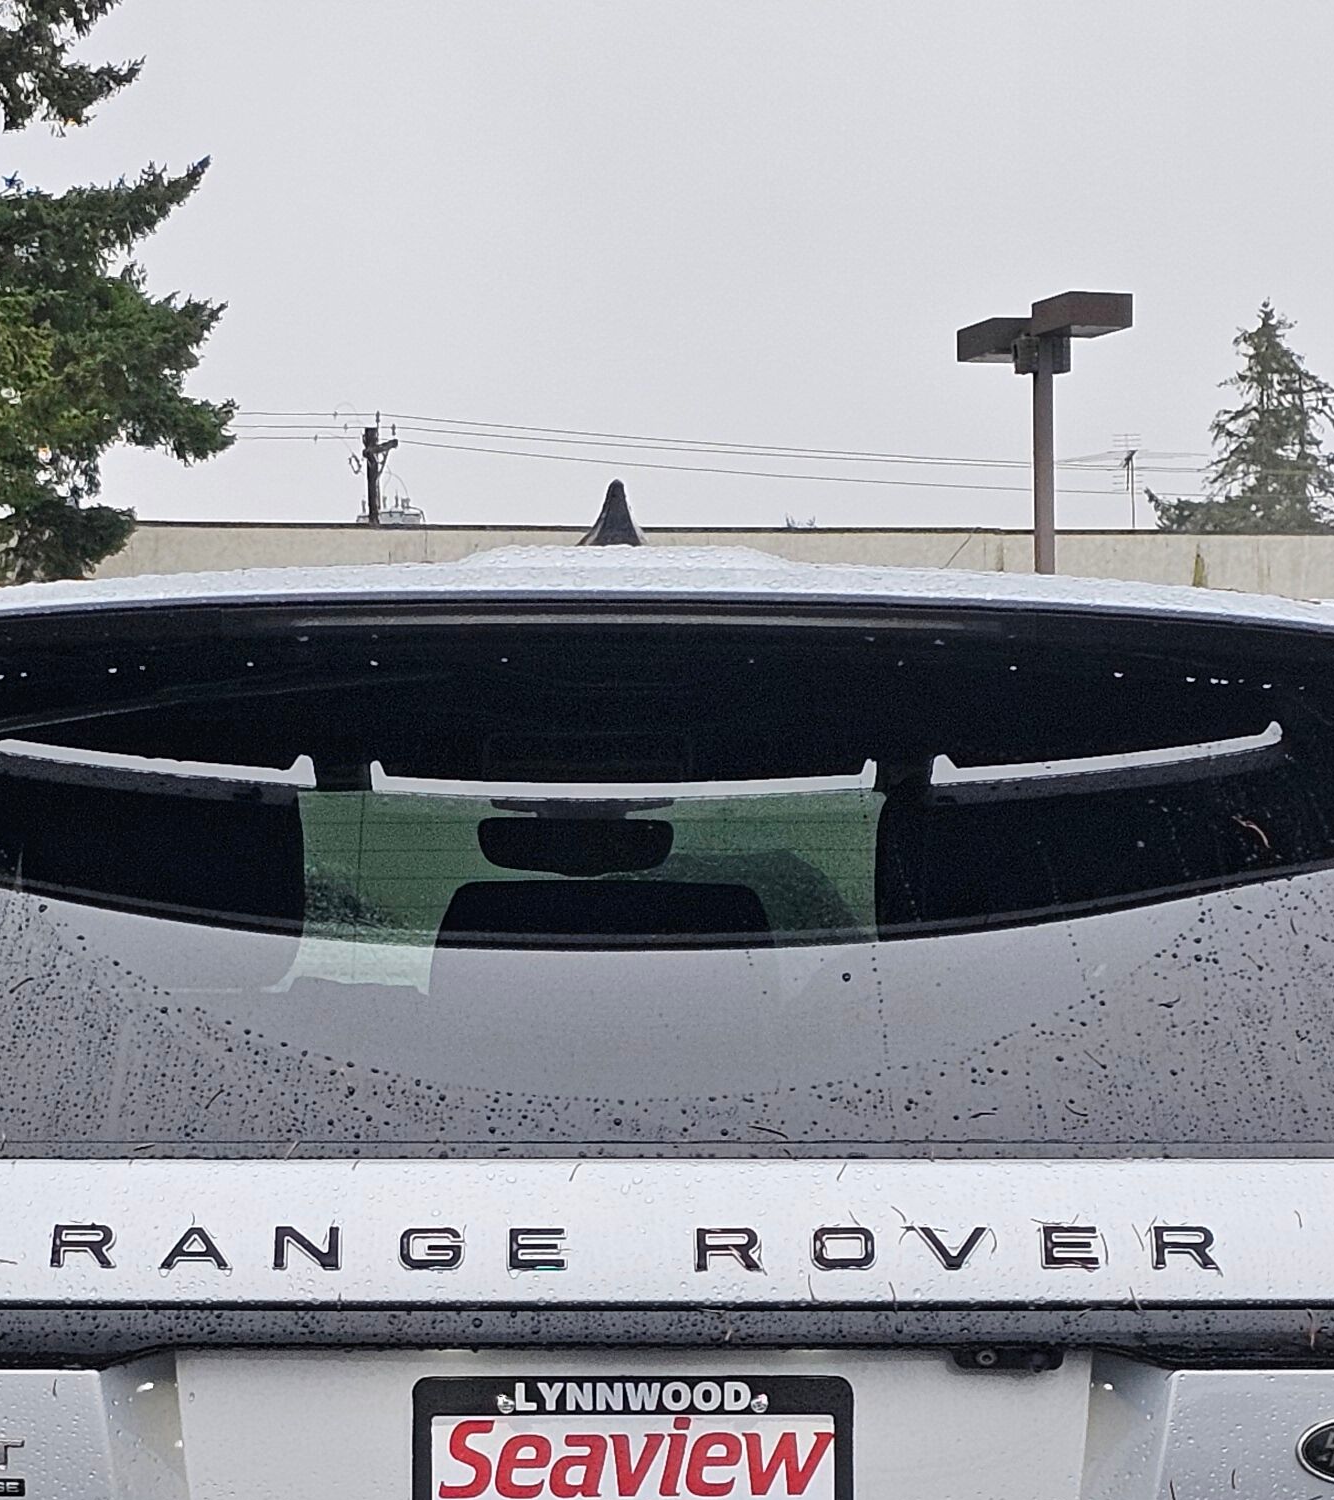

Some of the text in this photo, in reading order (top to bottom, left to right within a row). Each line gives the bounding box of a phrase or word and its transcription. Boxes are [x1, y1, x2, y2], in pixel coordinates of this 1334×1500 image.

[50, 1223, 1223, 1273] RANGE ROVER
[514, 1381, 752, 1412] LYNNWOOD
[438, 1417, 835, 1500] Seaview
